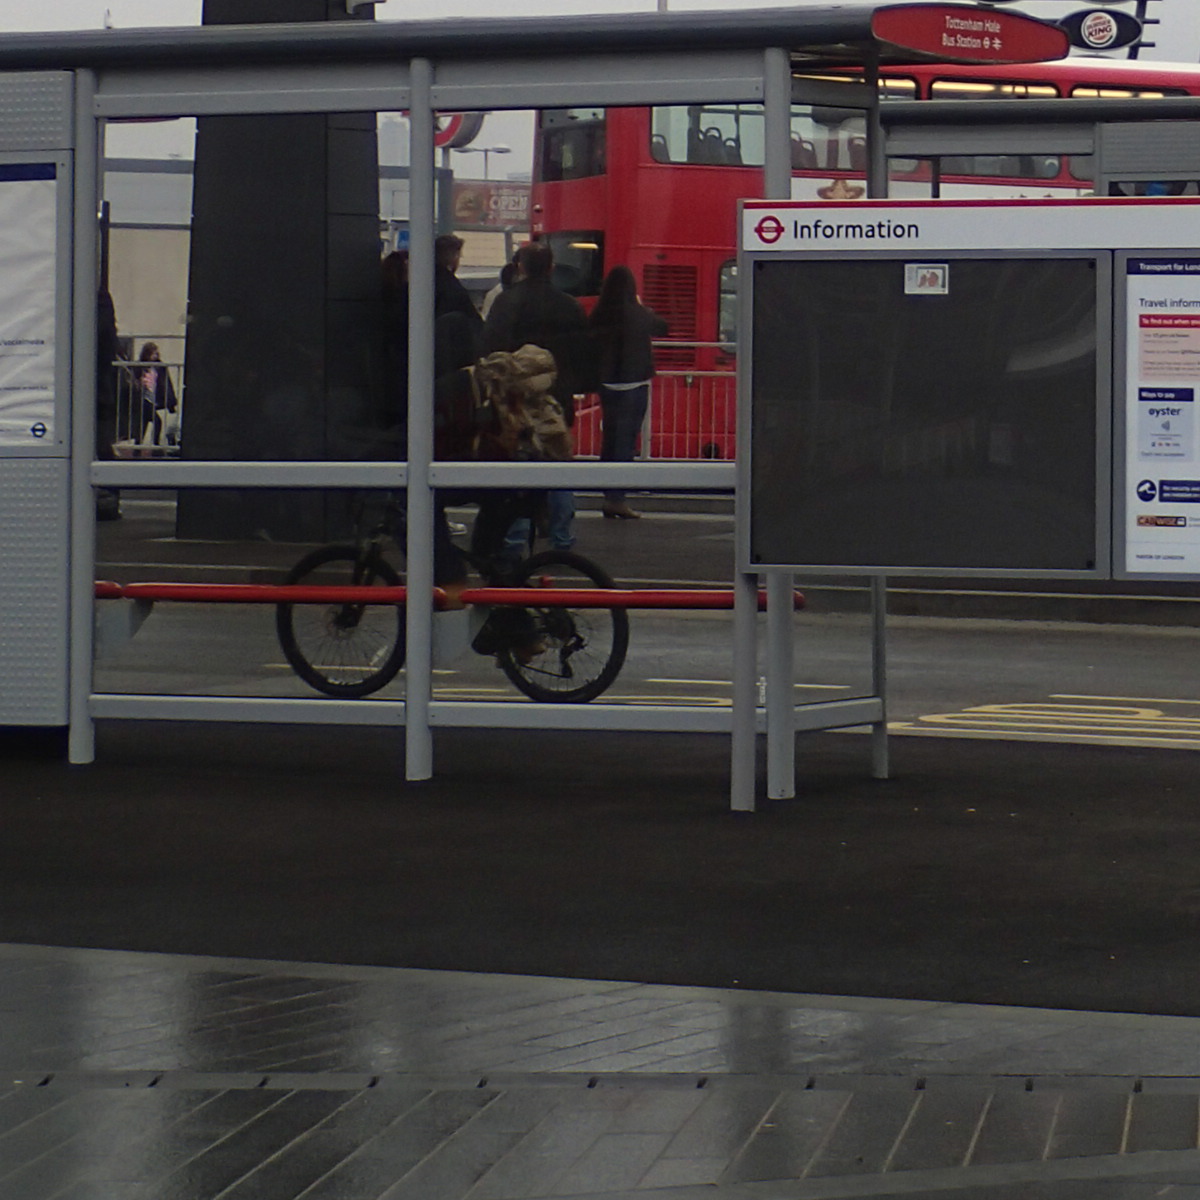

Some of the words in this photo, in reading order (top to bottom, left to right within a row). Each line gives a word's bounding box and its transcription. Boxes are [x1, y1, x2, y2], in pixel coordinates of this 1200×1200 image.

[945, 15, 983, 31] Tottenham
[984, 19, 1001, 33] Hale
[1087, 25, 1112, 39] KING
[942, 32, 955, 47] Bus
[956, 33, 982, 48] Station
[792, 219, 920, 240] Information
[1139, 262, 1172, 272] Transport
[1173, 262, 1183, 271] for
[1139, 298, 1167, 308] Travel
[1148, 406, 1182, 418] oyster
